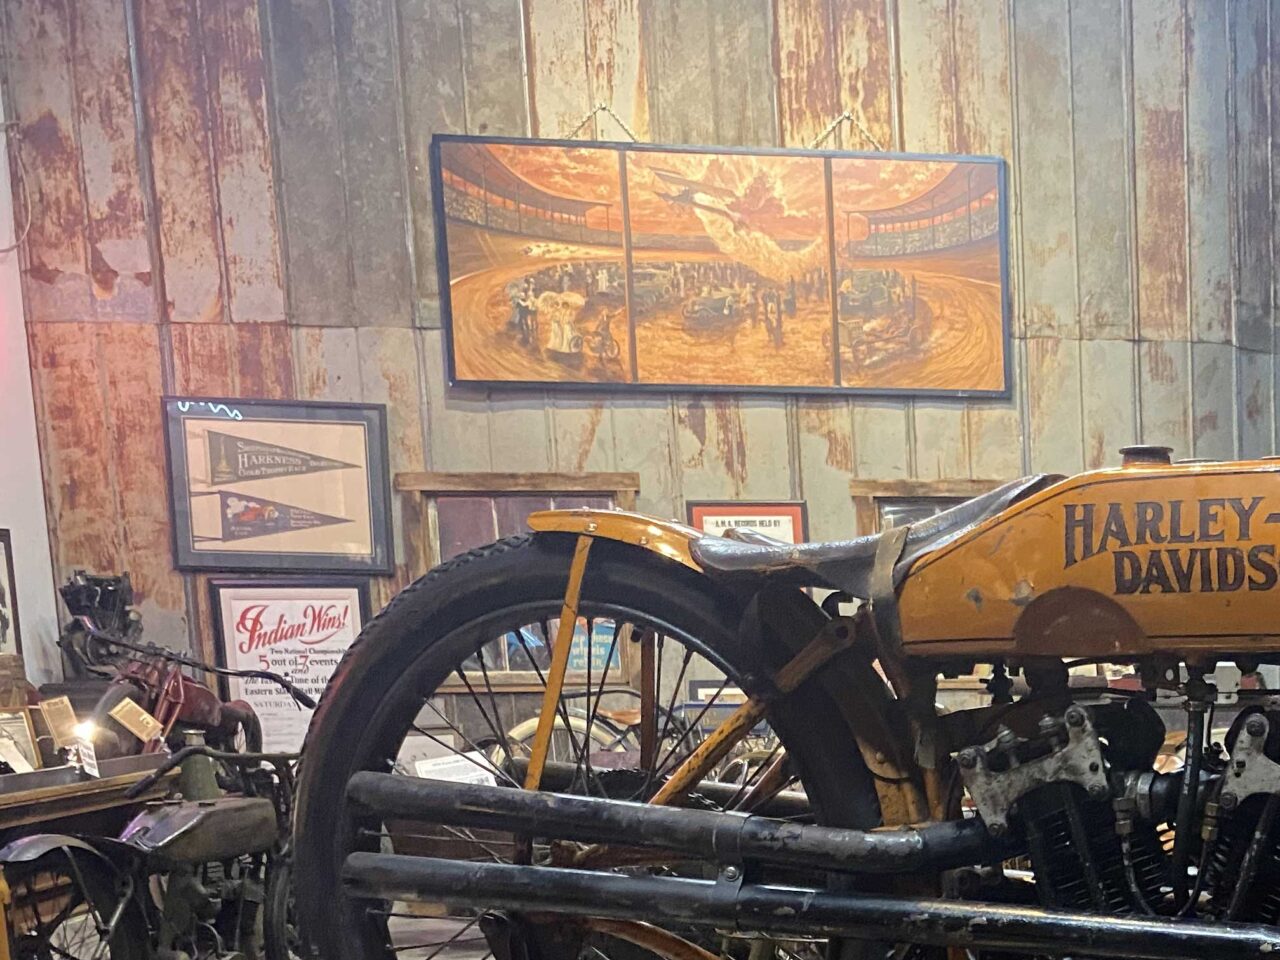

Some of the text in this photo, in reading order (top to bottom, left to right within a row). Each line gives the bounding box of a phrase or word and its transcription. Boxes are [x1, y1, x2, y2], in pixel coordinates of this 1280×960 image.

[734, 519, 758, 528] RECORDS
[758, 519, 772, 528] HELD
[773, 519, 781, 528] BY
[236, 604, 349, 654] Indian Wins!
[258, 655, 270, 671] 5
[271, 658, 286, 666] out
[289, 656, 298, 668] of
[290, 675, 309, 684] Time
[310, 675, 319, 684] of
[244, 687, 272, 695] Eastern
